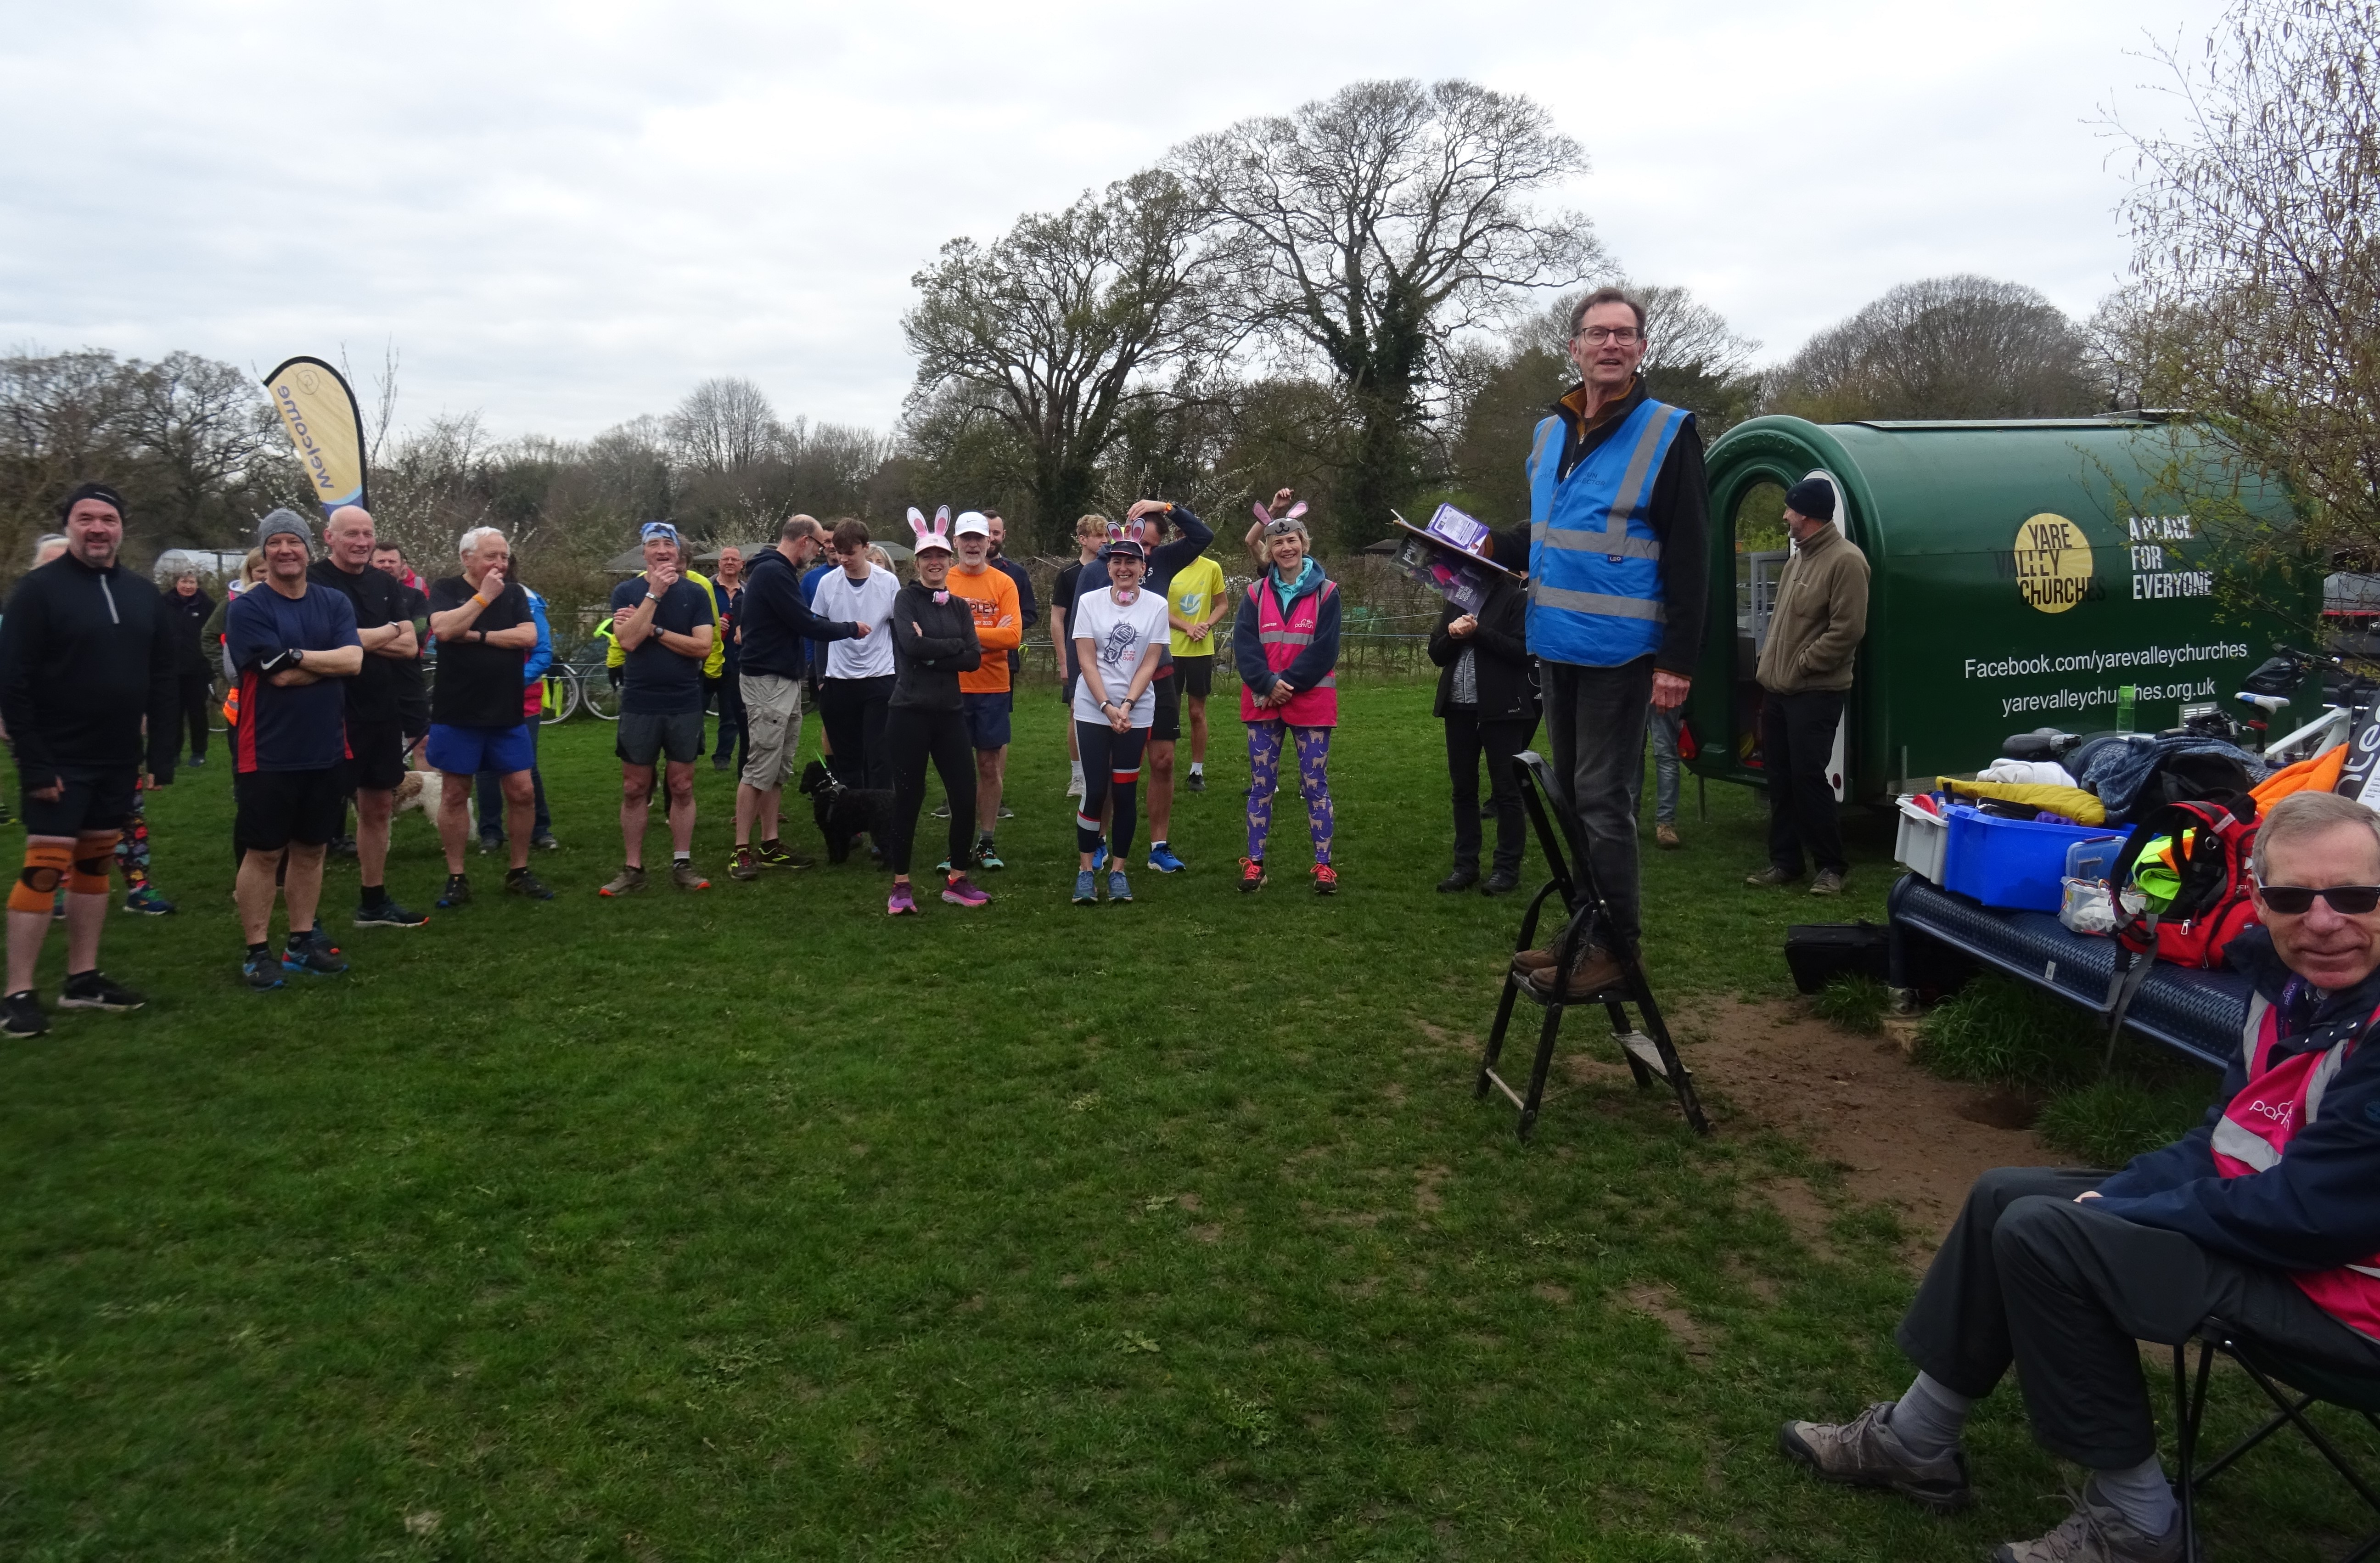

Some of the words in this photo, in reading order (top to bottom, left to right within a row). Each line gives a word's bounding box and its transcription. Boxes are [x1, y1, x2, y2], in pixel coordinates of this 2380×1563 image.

[2027, 523, 2072, 549] YARE
[2128, 517, 2140, 541] A
[2141, 515, 2194, 540] PLACE
[2131, 545, 2162, 570] FOR
[1455, 585, 1465, 598] WHEN
[1462, 588, 1473, 602] YOUNG
[2133, 571, 2213, 600] EVERYONE
[1295, 620, 1313, 629] parkrun
[1965, 641, 2247, 678] Facebook.com/yarevalleychurches
[2002, 677, 2216, 718] yarevalleychuhes.org.uk
[2283, 983, 2297, 1006] parkrun
[2249, 1100, 2294, 1132] park
